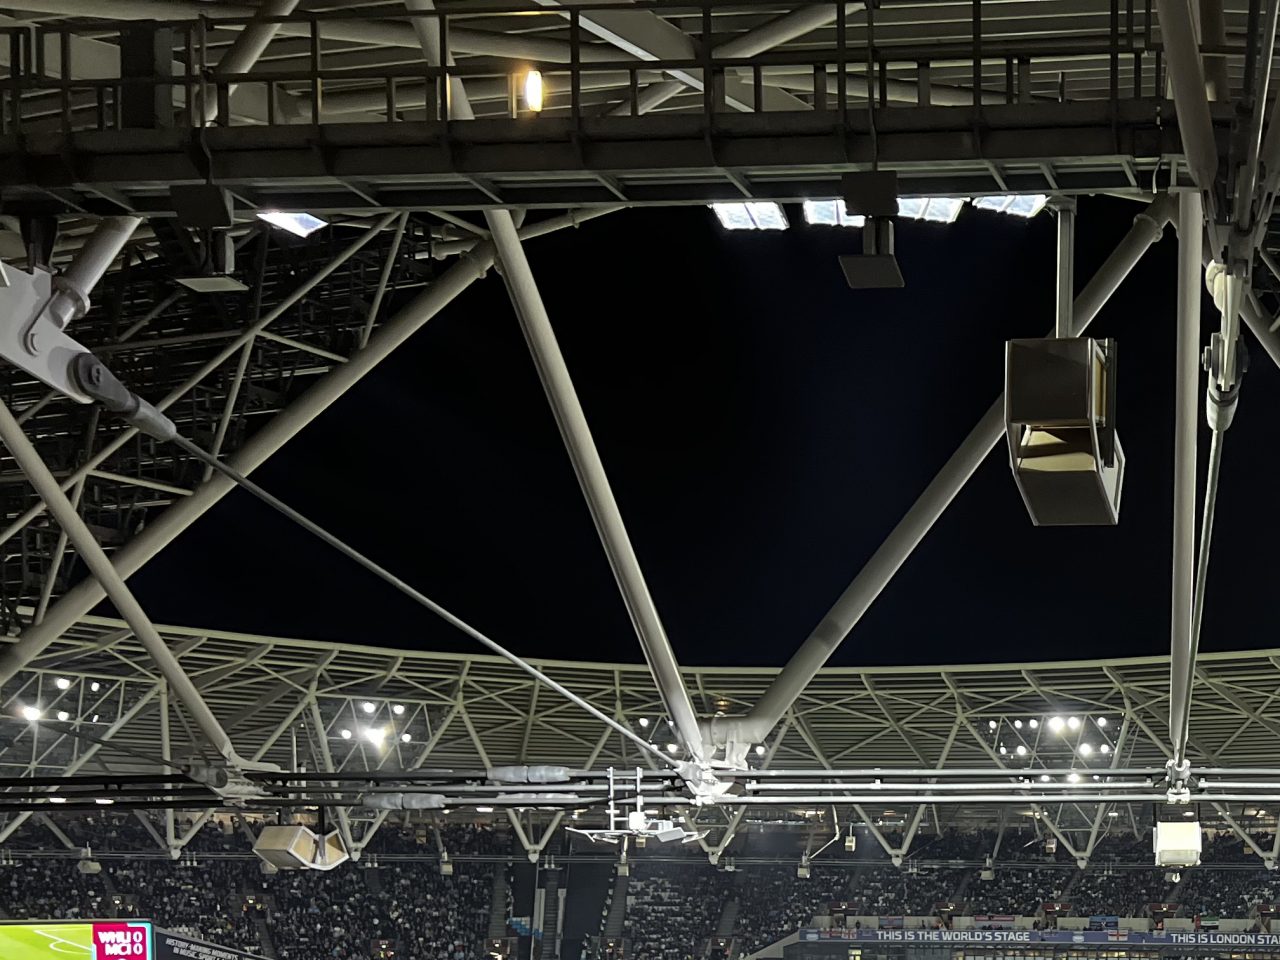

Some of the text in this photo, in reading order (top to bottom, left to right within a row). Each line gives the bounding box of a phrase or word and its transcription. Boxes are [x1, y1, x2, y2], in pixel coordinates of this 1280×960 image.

[133, 931, 142, 943] 0
[877, 931, 1030, 942] THIS IS THE WORLD'S STAGE
[1170, 933, 1195, 943] THIS
[1198, 934, 1208, 943] IS
[1210, 934, 1254, 944] LONDON
[133, 943, 143, 955] 0
